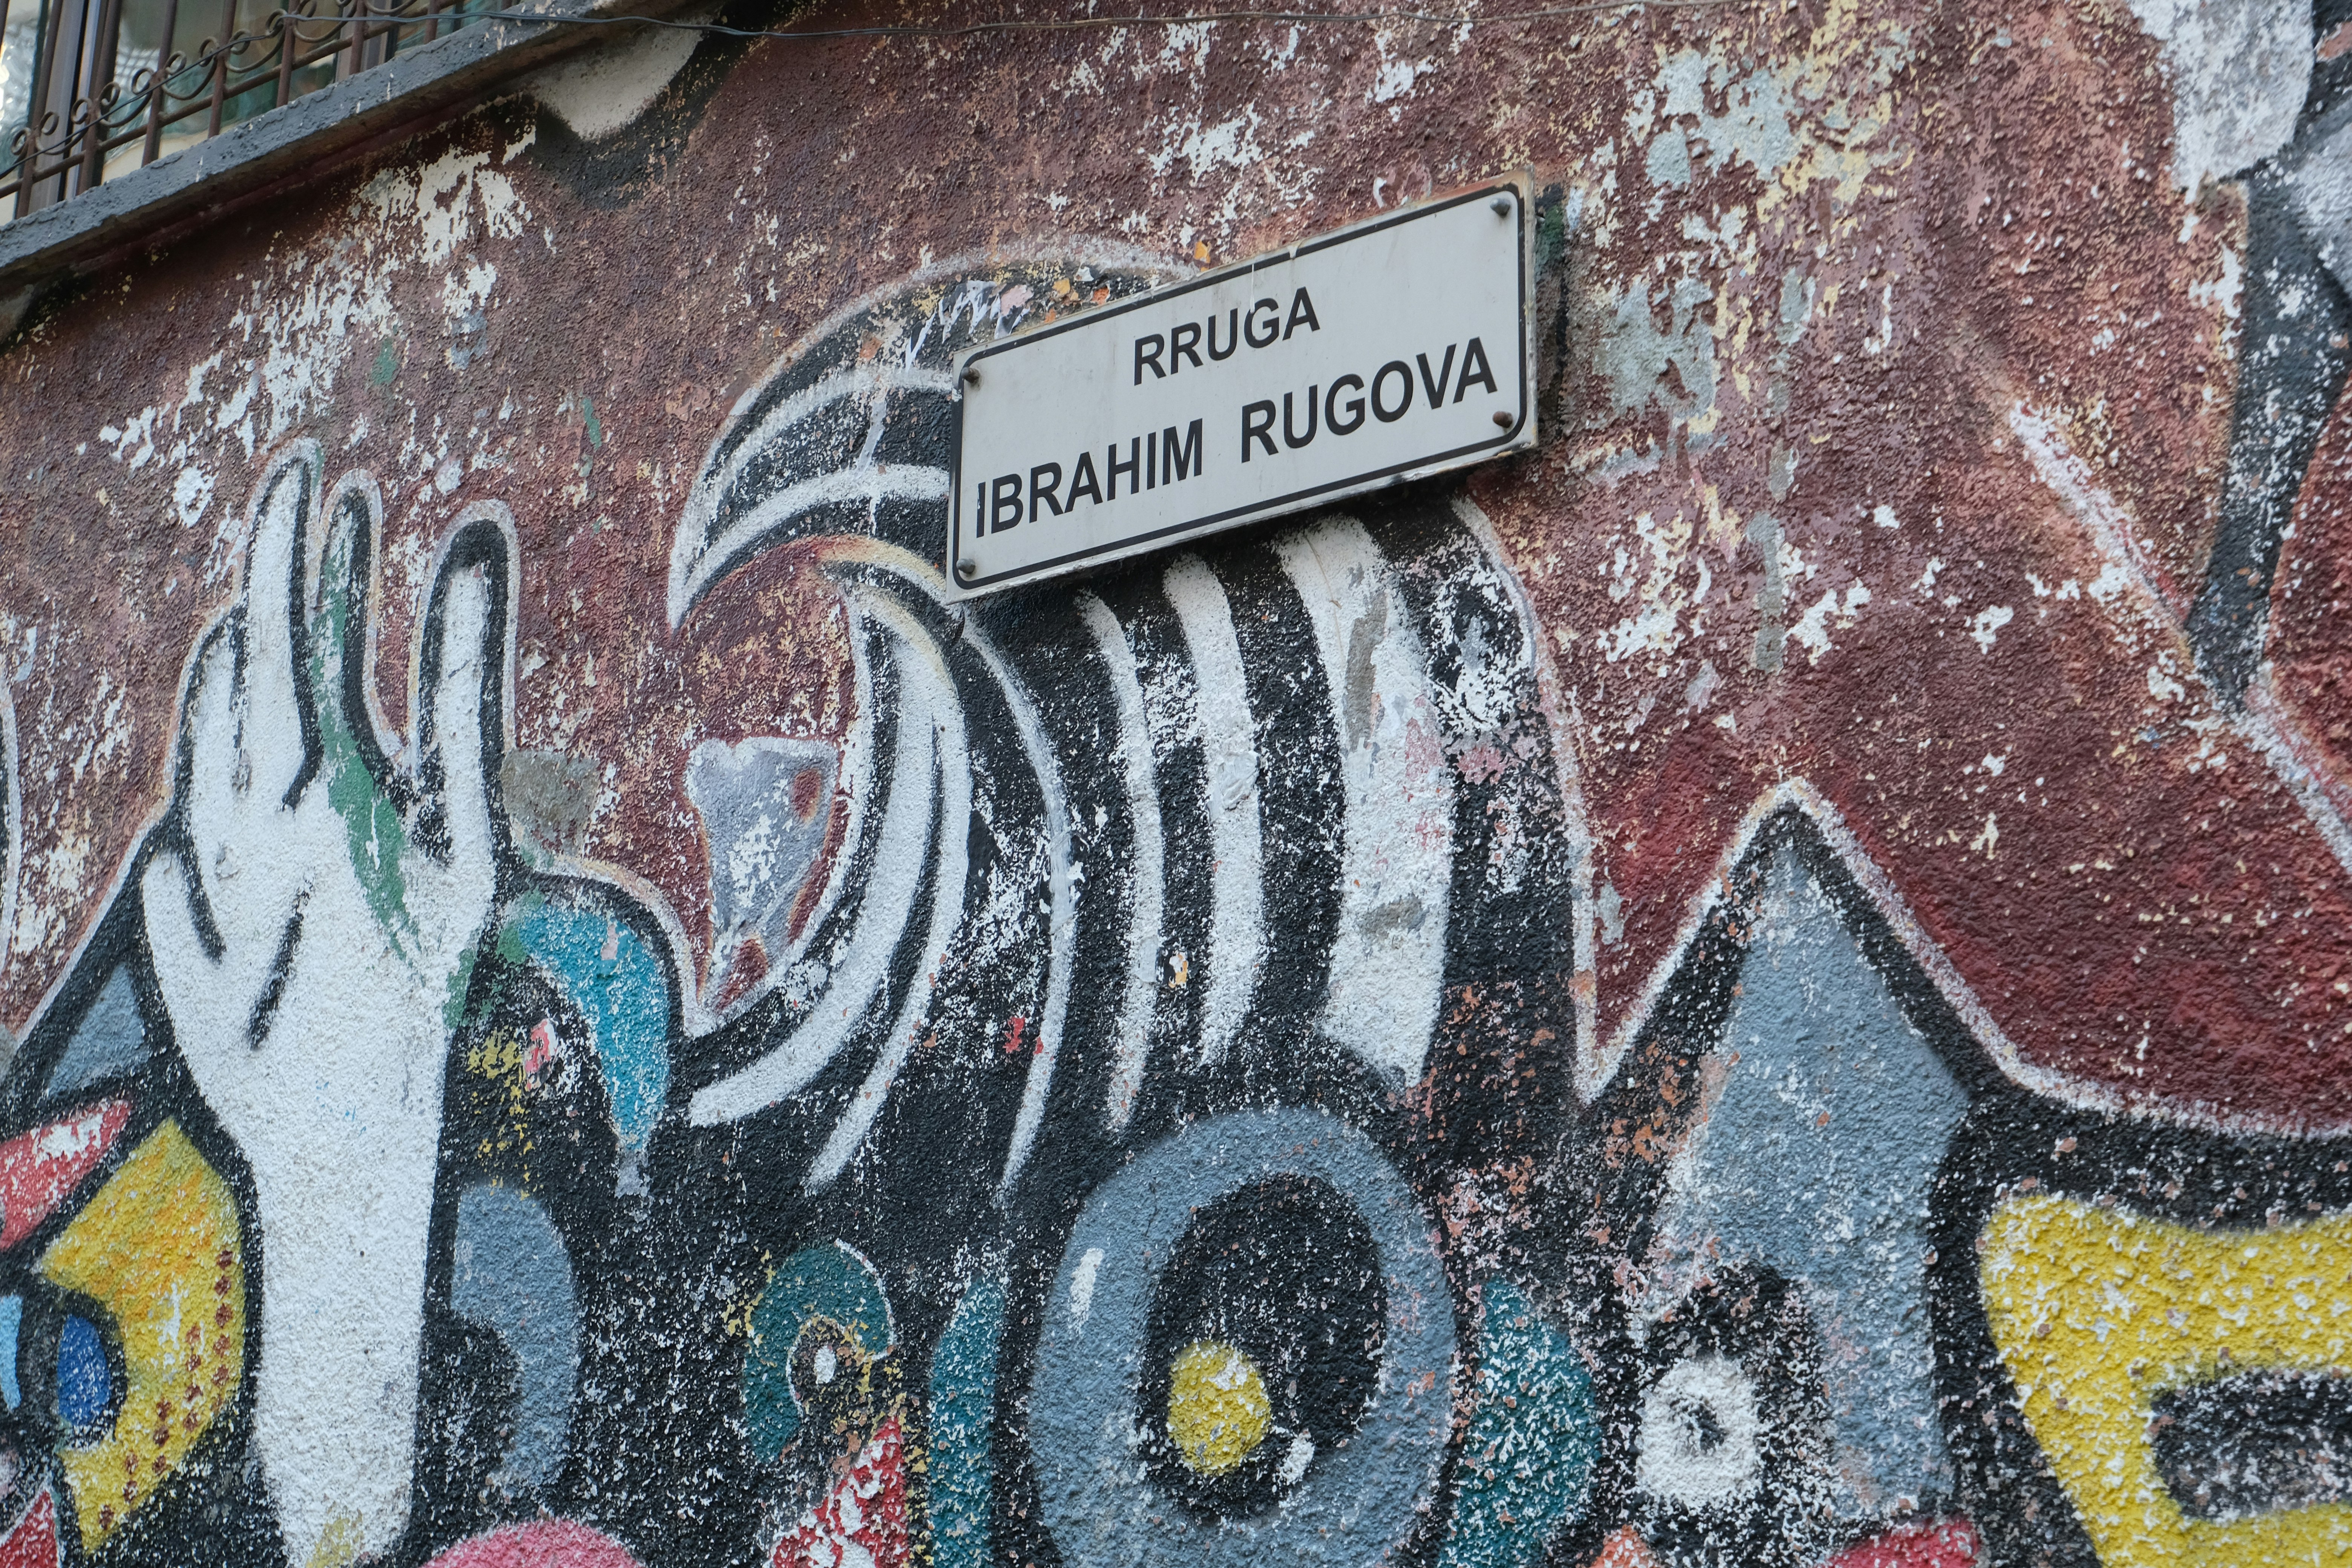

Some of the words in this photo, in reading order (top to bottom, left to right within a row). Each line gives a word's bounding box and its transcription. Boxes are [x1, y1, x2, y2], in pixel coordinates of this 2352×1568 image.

[1134, 286, 1320, 386] RRUGA
[976, 418, 1203, 538] IBRAHIM
[1241, 337, 1498, 463] RUGOVA
